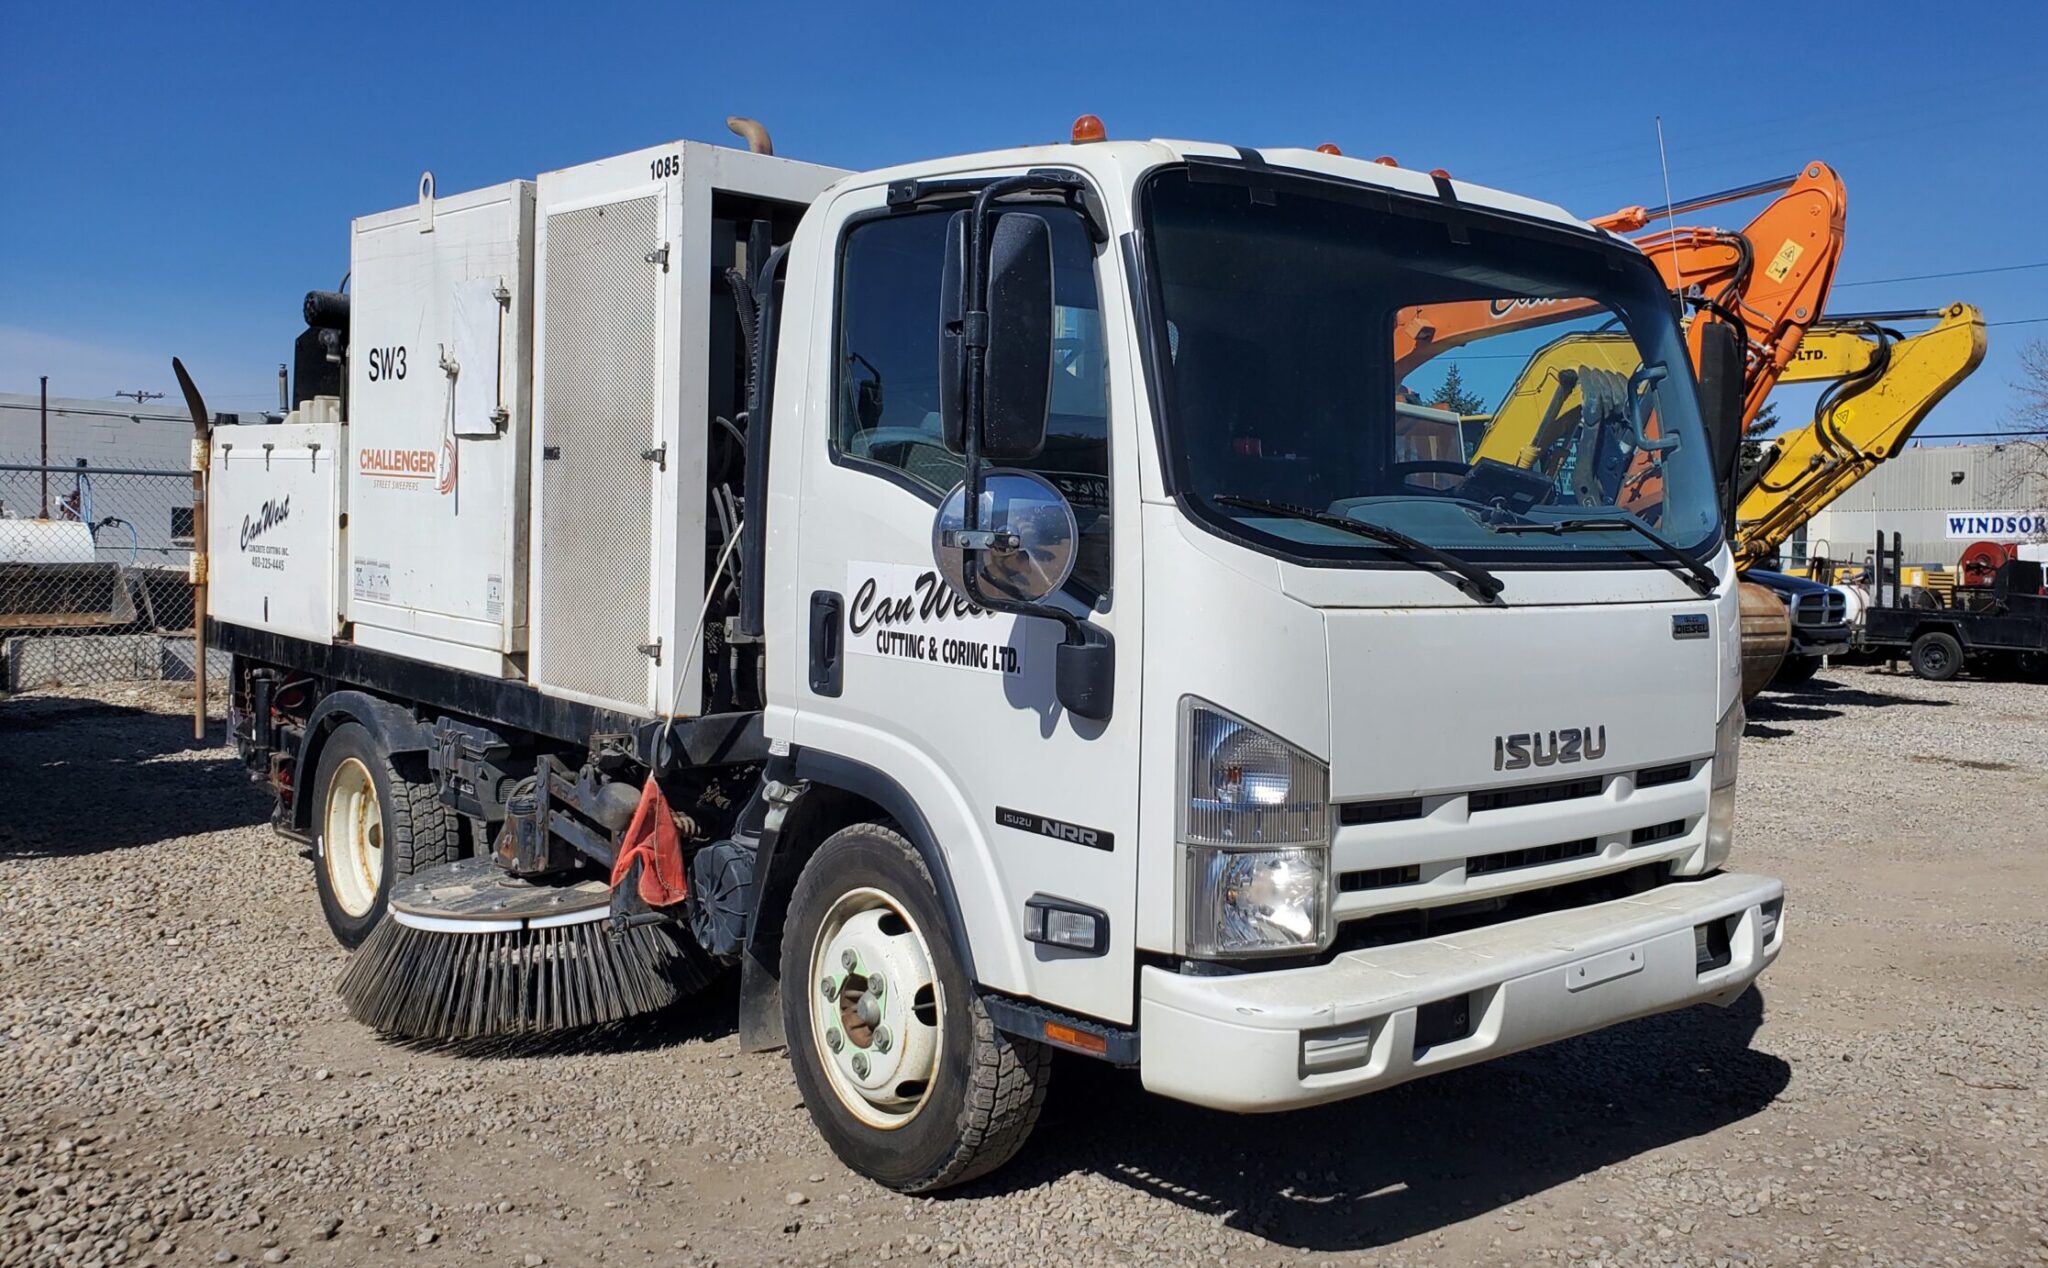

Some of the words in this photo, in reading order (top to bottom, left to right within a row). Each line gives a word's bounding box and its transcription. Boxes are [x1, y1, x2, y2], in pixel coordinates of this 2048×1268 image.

[650, 154, 680, 181] 1085
[368, 345, 407, 382] SW3
[1798, 349, 1828, 361] LTD.
[359, 448, 436, 472] CHALLENGER
[373, 479, 391, 489] STREET
[391, 480, 420, 491] SWEEPERS
[1949, 515, 2047, 534] WINDSOR
[1674, 623, 1709, 634] DIESEL
[876, 629, 925, 660] CUTTING
[928, 636, 938, 662] &
[942, 637, 988, 669] CORING
[992, 645, 1021, 674] LTD.
[1494, 725, 1607, 771] ISUZU
[1004, 812, 1032, 828] ISUZU
[1041, 819, 1098, 846] NRR
